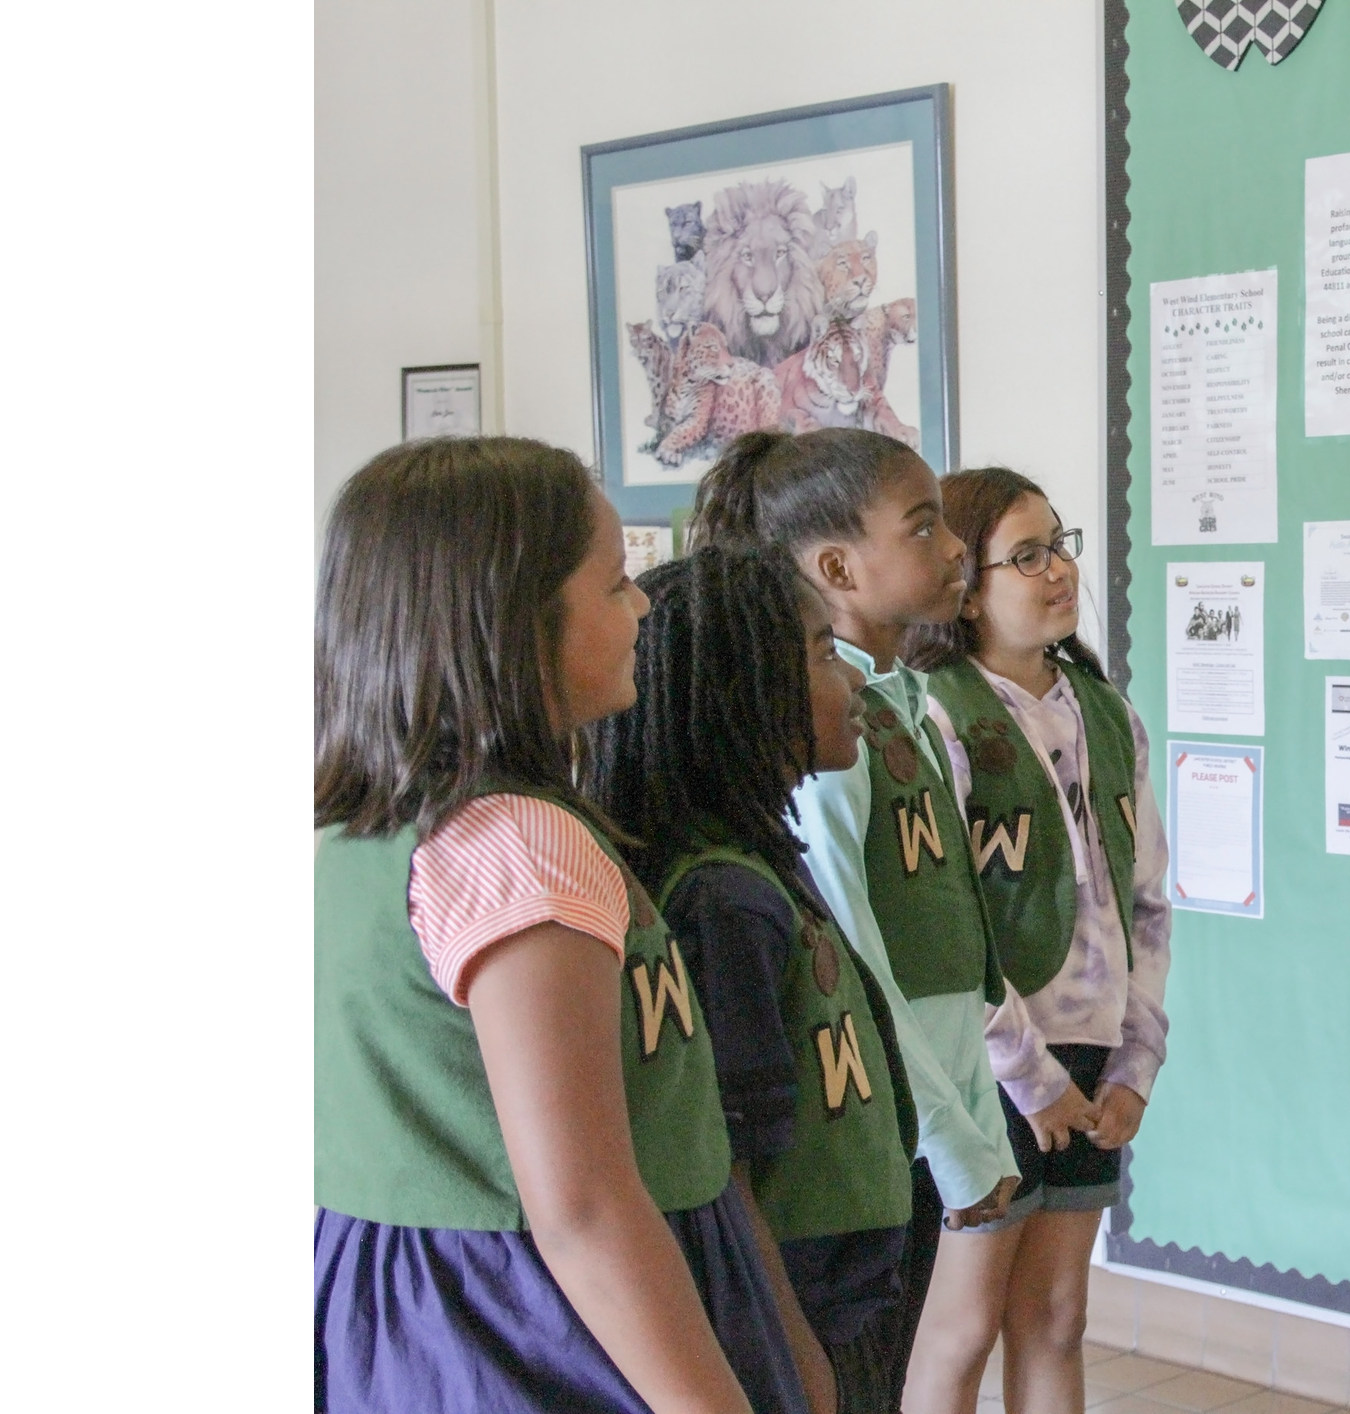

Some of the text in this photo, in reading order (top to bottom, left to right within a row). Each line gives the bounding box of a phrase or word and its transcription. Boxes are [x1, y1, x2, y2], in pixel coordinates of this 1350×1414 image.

[1162, 287, 1264, 306] West Wind Elementary School
[1172, 301, 1253, 317] CHARACTER TRAITS
[1317, 315, 1337, 326] Being
[1320, 328, 1343, 339] school
[1326, 343, 1346, 353] Penal
[1316, 357, 1337, 368] result
[1338, 358, 1345, 366] in
[1321, 371, 1345, 383] and/or
[1191, 771, 1240, 784] PLEASE POST
[896, 788, 945, 875] W
[968, 808, 1033, 877] W
[629, 934, 695, 1060] W
[814, 1010, 873, 1116] W
